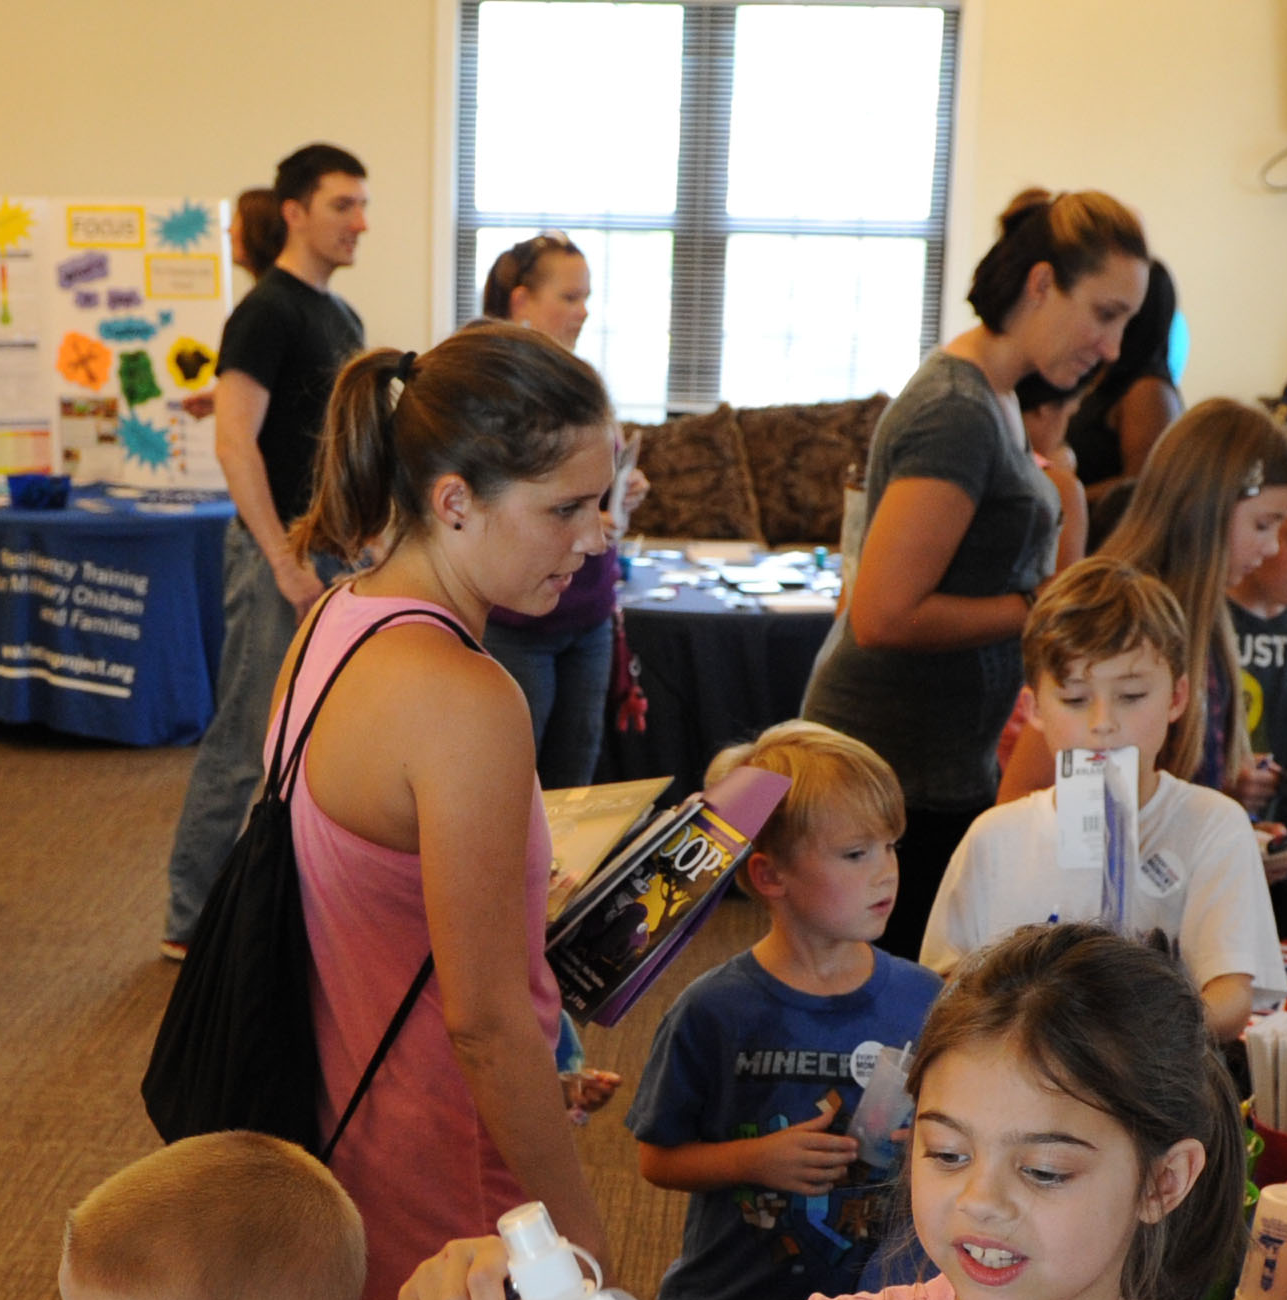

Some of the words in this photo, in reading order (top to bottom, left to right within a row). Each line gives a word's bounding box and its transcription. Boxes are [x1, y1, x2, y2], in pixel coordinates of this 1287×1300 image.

[0, 548, 78, 582] Resiliency
[83, 561, 149, 596] Training
[72, 585, 145, 616] Children
[70, 608, 141, 641] Families
[735, 1050, 852, 1078] MINECR
